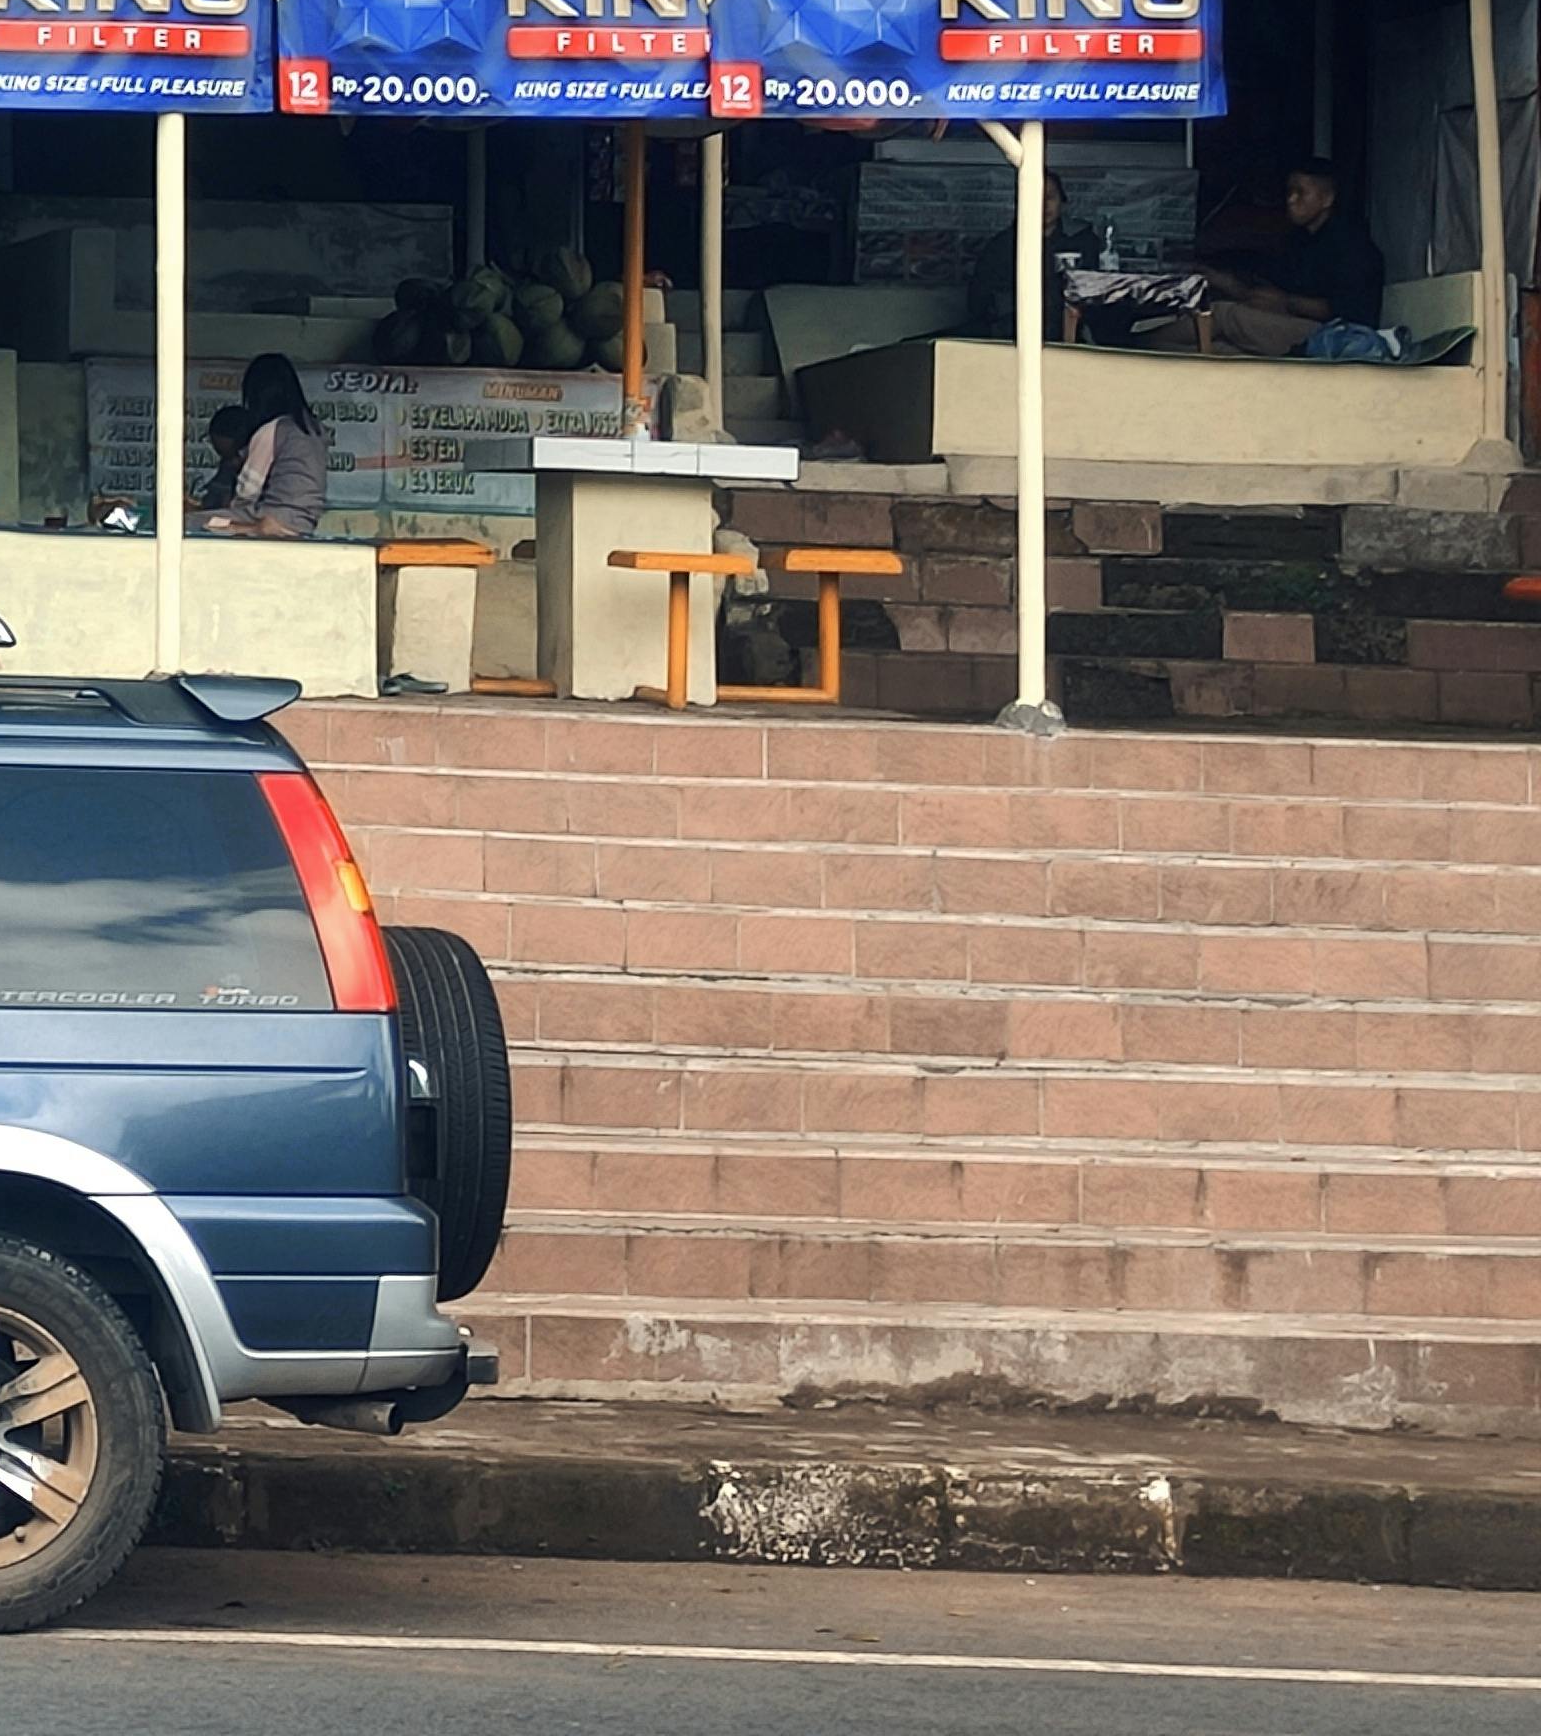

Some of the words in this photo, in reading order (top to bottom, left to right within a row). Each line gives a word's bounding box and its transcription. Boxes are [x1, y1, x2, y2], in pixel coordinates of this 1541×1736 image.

[37, 25, 203, 50] FILTER
[989, 34, 1155, 55] FILTER
[45, 75, 89, 93] SIZE
[100, 76, 146, 94] FULL
[150, 77, 245, 97] PLEASURE
[289, 71, 317, 99] 12
[515, 81, 561, 99] KING
[565, 81, 607, 100] SIZE
[619, 82, 666, 100] FULL
[720, 76, 750, 102] 12
[948, 84, 994, 101] KING
[998, 84, 1041, 101] SIZE
[1053, 84, 1099, 101] FULL
[1104, 84, 1200, 102] PLEASURE
[326, 370, 418, 393] SEDIA:
[198, 991, 299, 1006] TURBO
